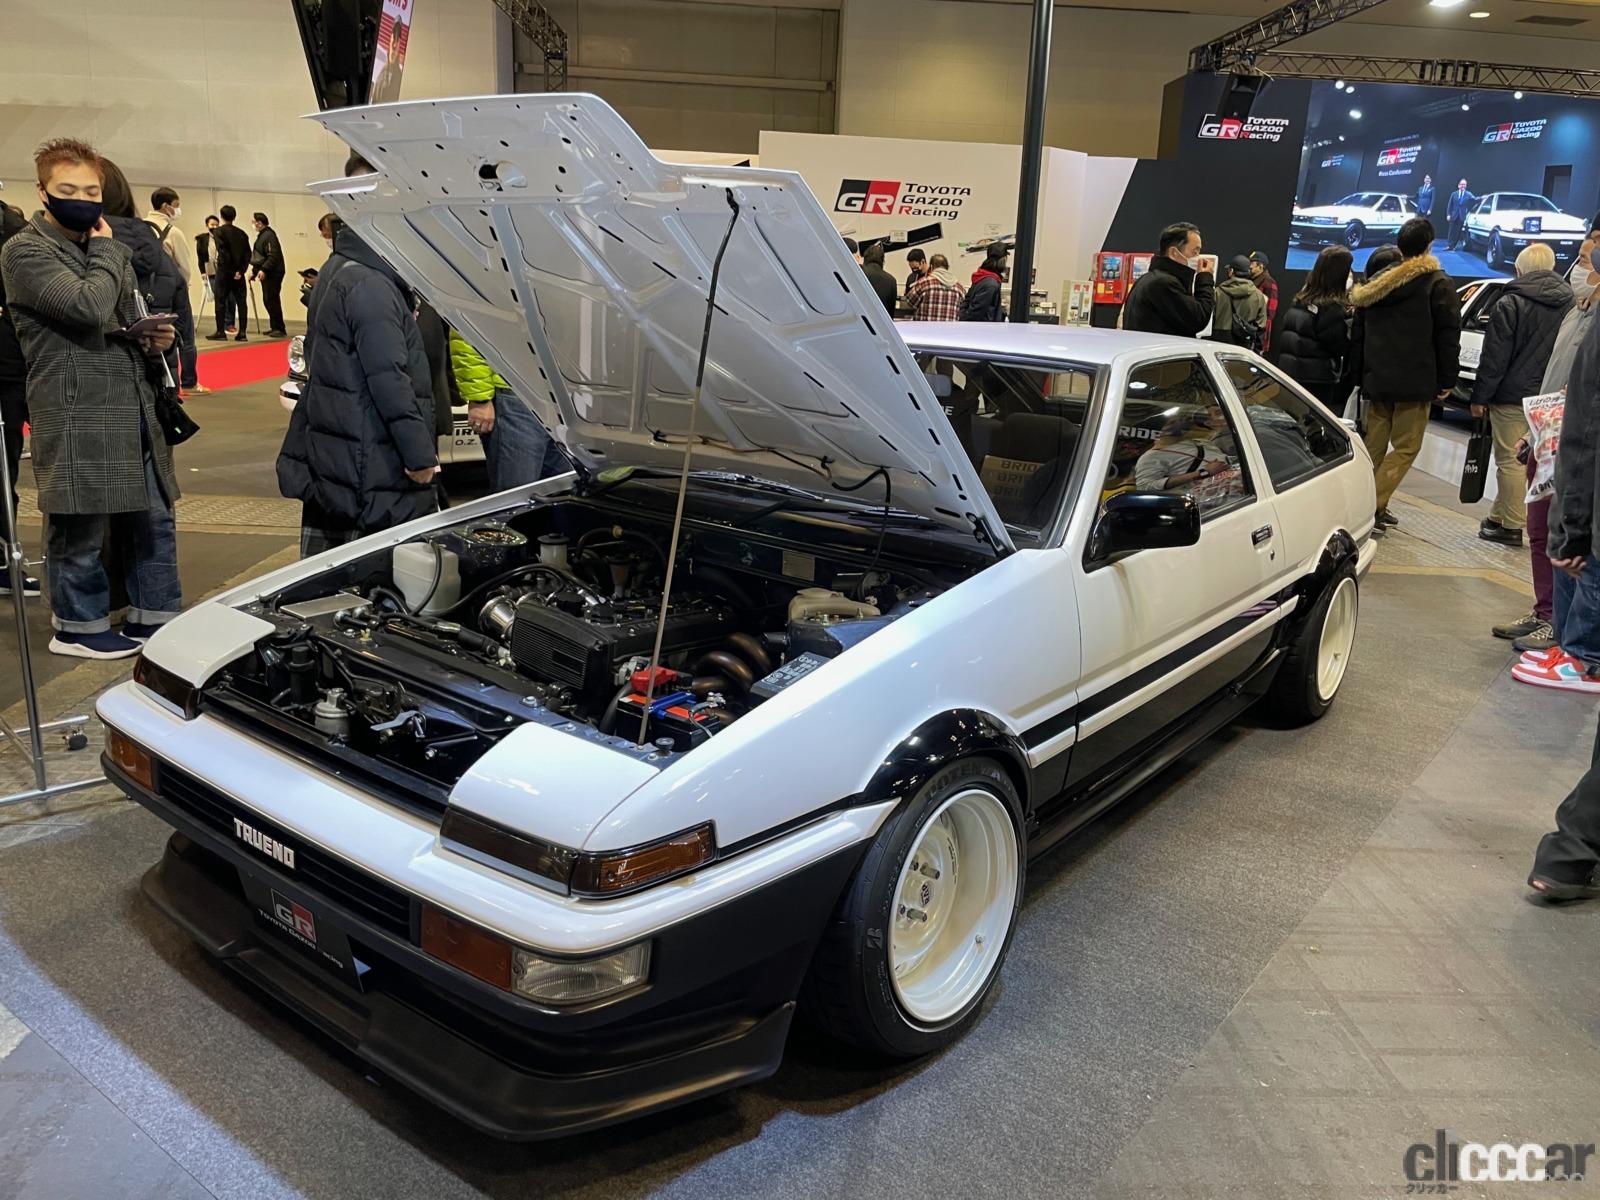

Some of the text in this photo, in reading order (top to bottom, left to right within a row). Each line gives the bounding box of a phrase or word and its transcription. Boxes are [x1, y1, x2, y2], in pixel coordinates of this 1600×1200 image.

[1247, 116, 1290, 126] TOYOTA
[1514, 119, 1548, 128] TOYOTA
[1242, 124, 1284, 133] GAZOO
[1511, 125, 1543, 134] GAZOO
[1240, 131, 1281, 142] Racing
[905, 183, 971, 196] TOYOTA
[901, 194, 963, 207] GAZOO
[898, 205, 958, 221] Racing
[233, 817, 296, 870] TRUENO
